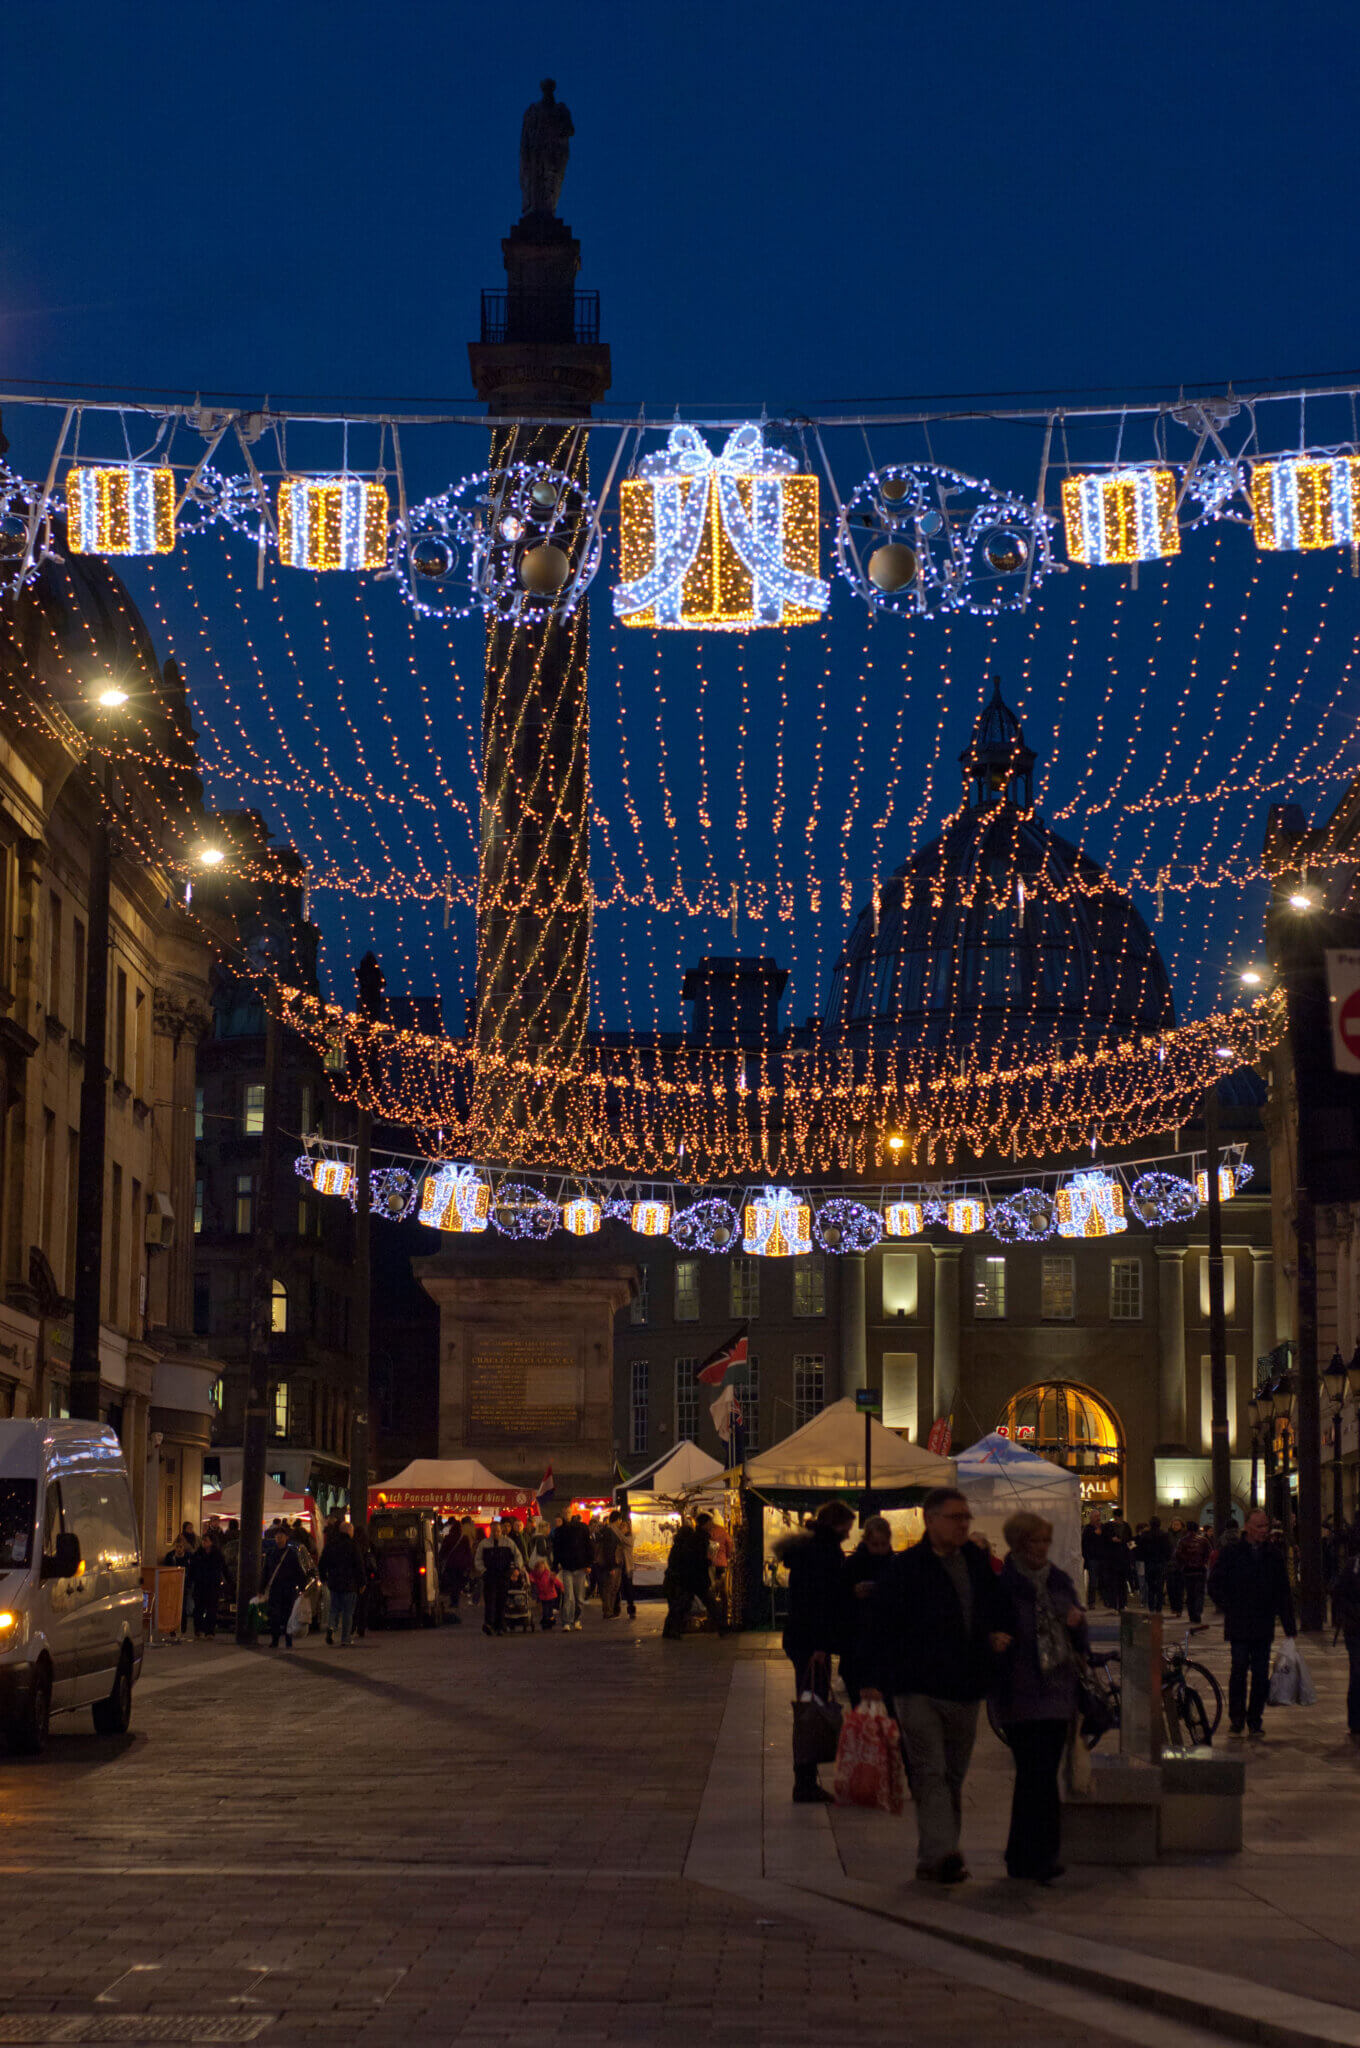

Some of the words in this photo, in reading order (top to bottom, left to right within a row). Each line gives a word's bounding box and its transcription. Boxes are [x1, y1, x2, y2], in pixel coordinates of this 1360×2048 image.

[384, 1492, 403, 1502] utch
[404, 1492, 443, 1503] Pancakes
[445, 1493, 451, 1502] &
[453, 1492, 484, 1502] Mulled
[485, 1493, 506, 1503] Wine
